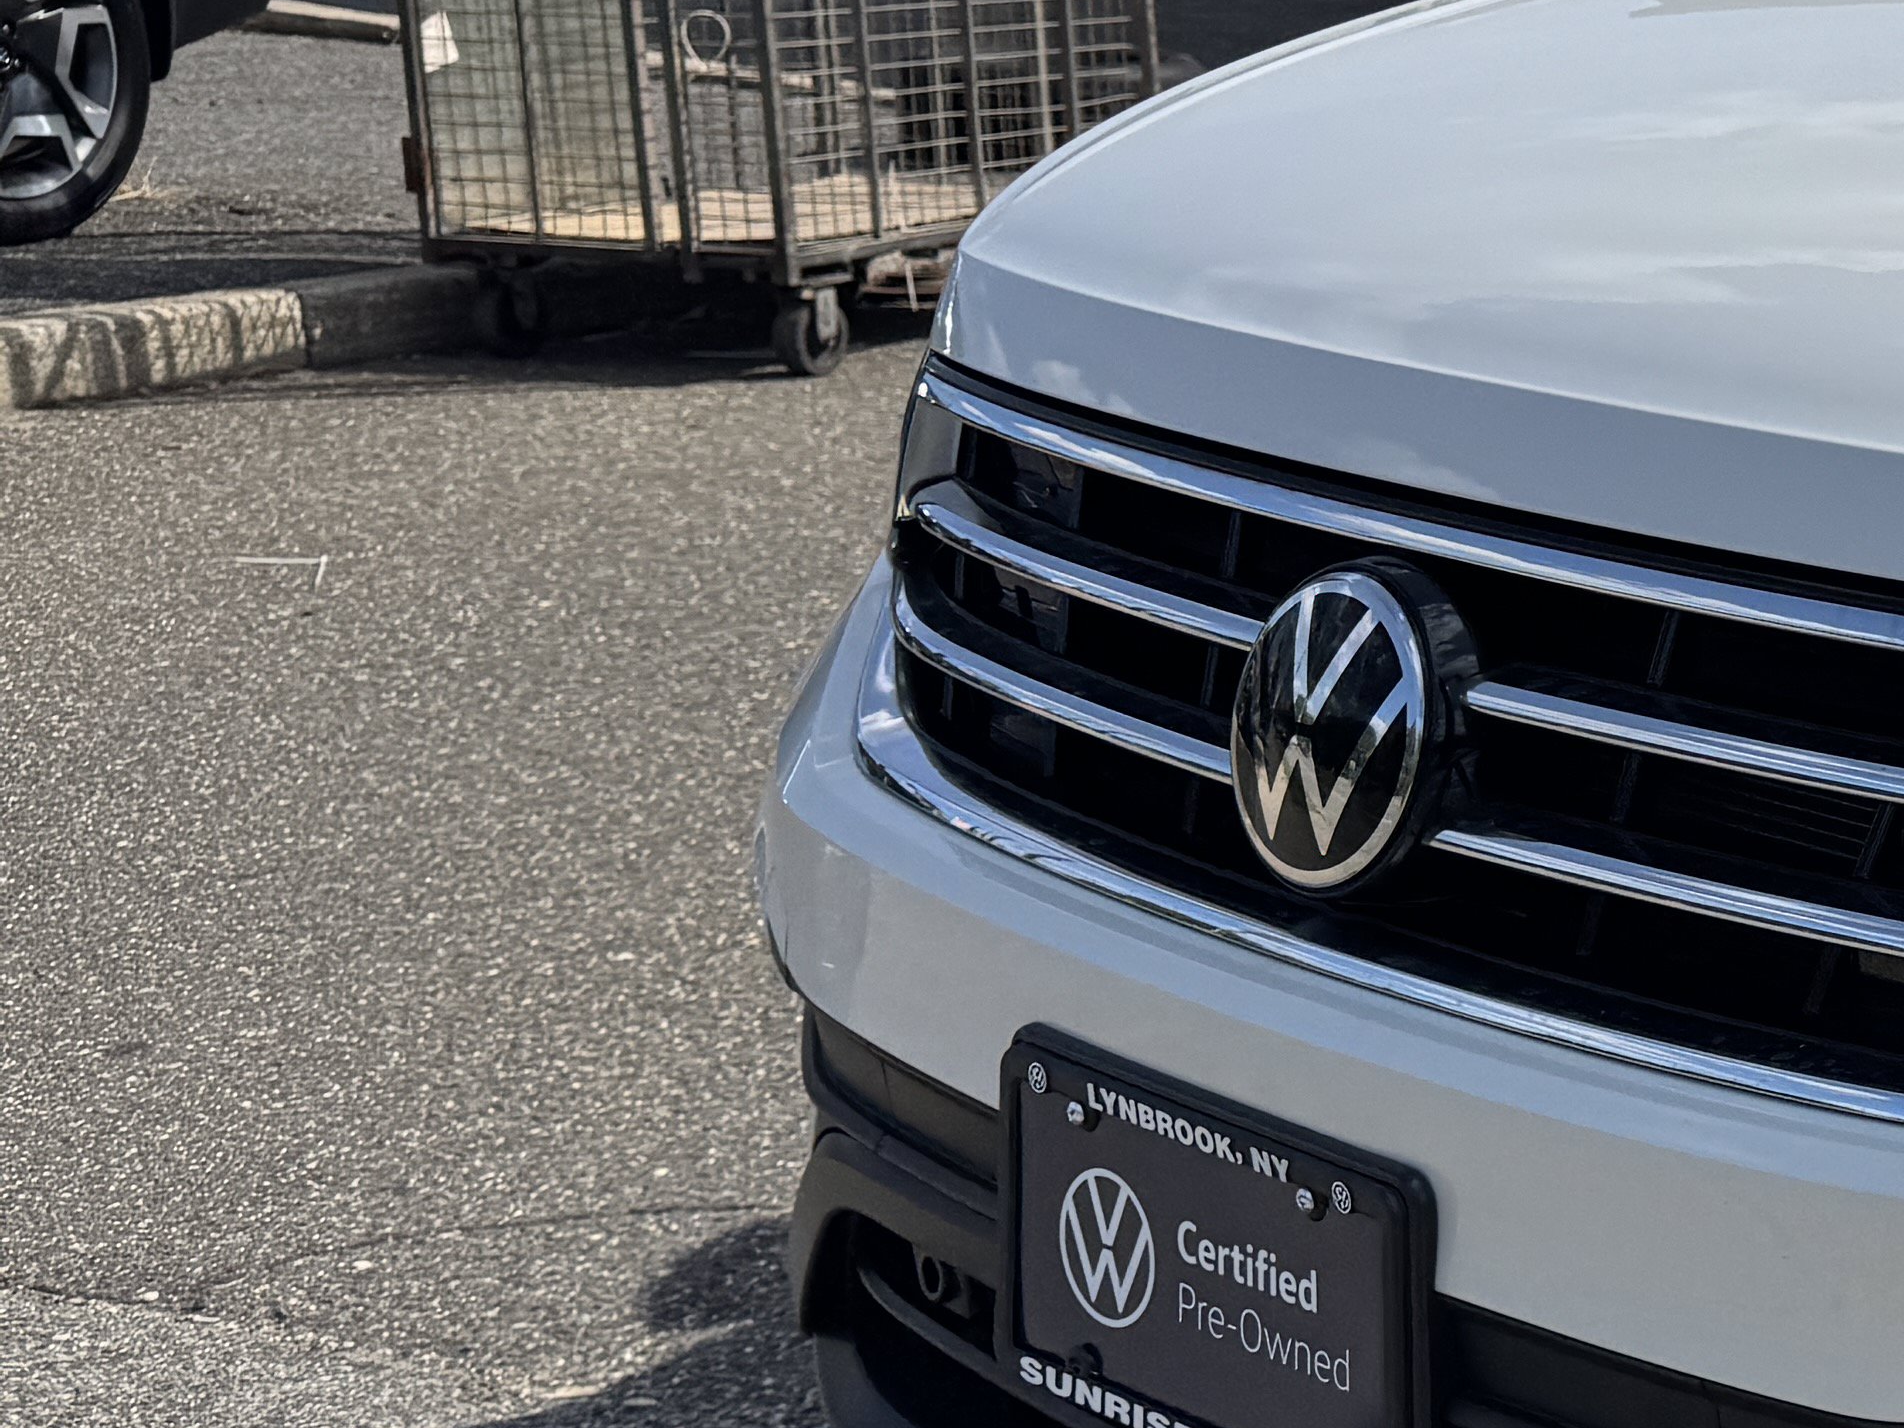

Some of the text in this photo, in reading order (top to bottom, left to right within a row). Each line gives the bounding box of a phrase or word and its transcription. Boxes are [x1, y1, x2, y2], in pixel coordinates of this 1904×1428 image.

[1086, 1082, 1289, 1182] LYNBROOK, NY
[1177, 1221, 1317, 1312] Certified
[1178, 1282, 1350, 1391] Pre-Owned
